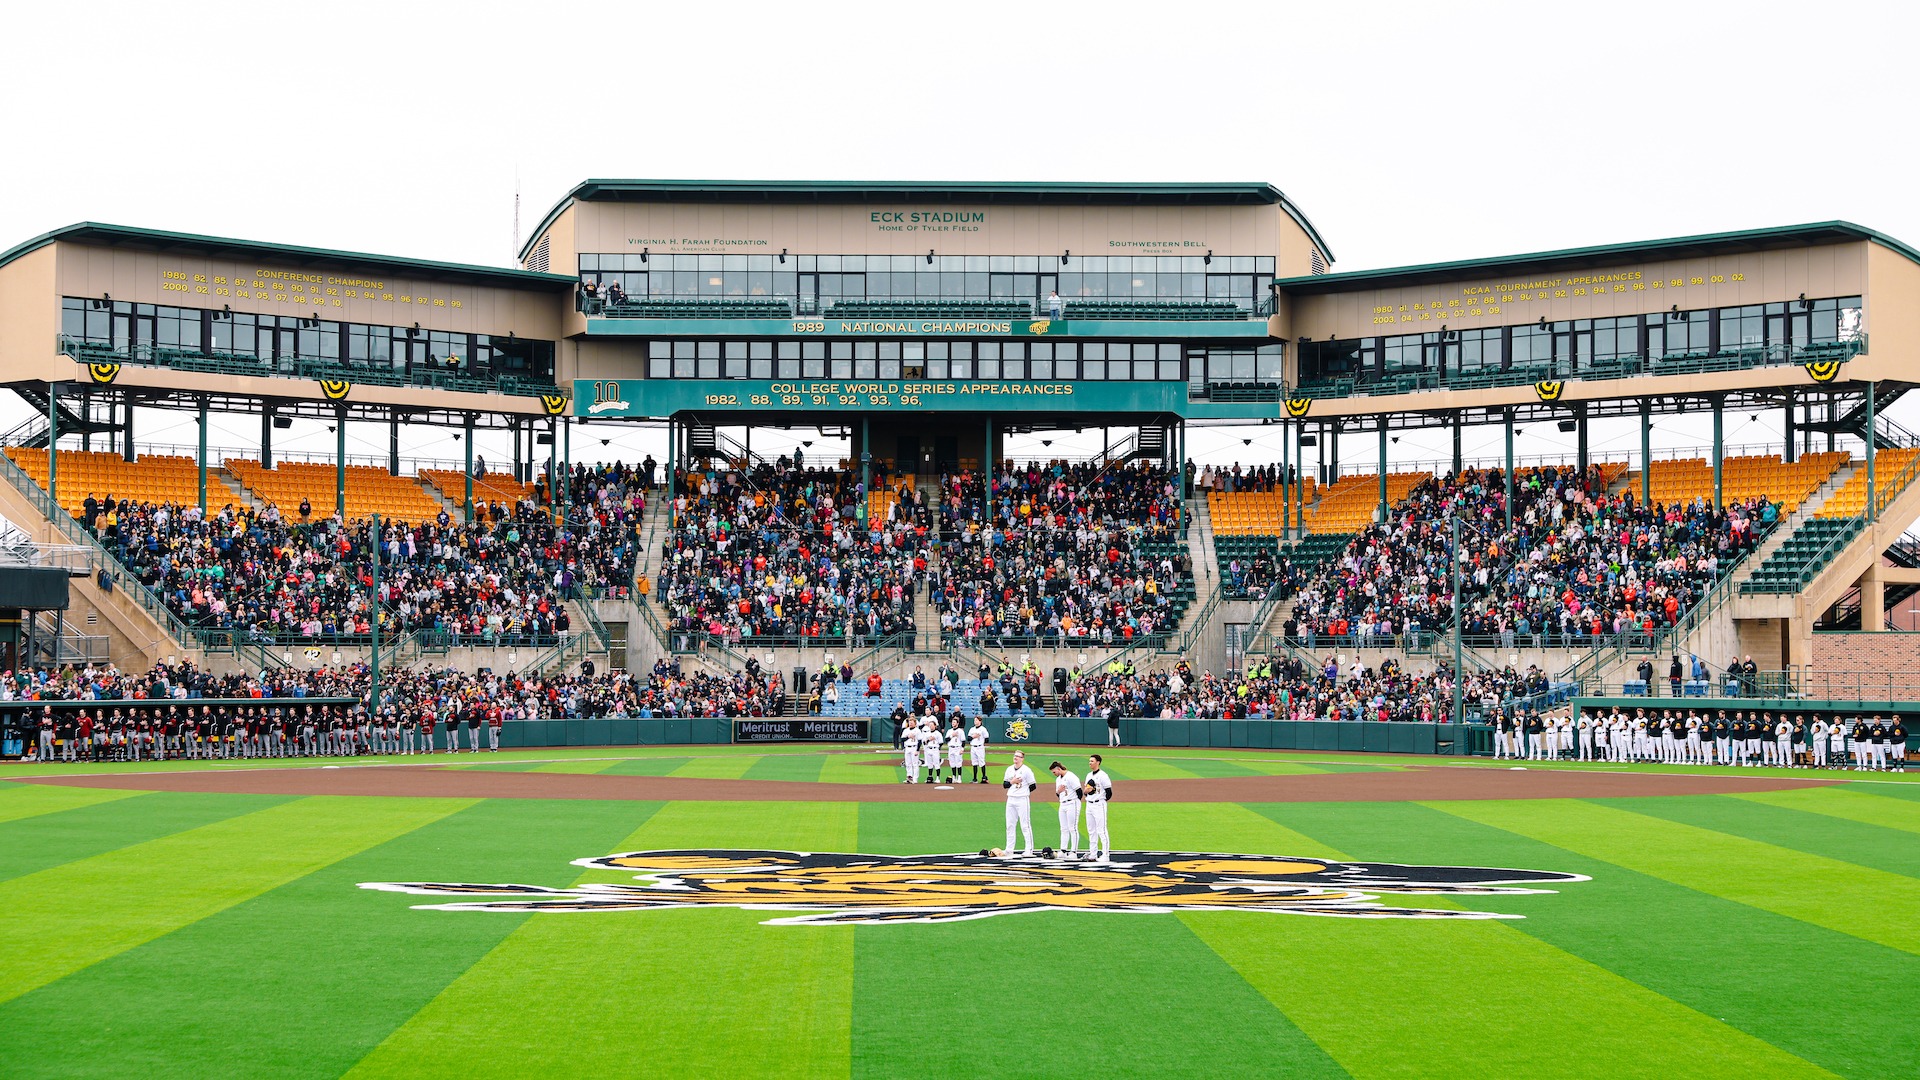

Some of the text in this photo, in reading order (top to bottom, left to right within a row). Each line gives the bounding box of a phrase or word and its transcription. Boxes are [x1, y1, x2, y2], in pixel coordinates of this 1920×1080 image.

[870, 212, 984, 222] ECK STADIUM
[256, 269, 384, 290] CONFERENCE CHAMPIONS
[1463, 271, 1642, 296] NCAA TOURNAMENT APPEARANCES
[792, 322, 1011, 332] 1989 NATIONAL CHAMPIONS
[594, 381, 620, 404] 10
[771, 383, 1073, 394] COLLEGE WORLD SERIES APPEARANCES
[705, 395, 742, 406] 1982,
[742, 722, 790, 732] Meritrust
[804, 722, 858, 732] Meritrust
